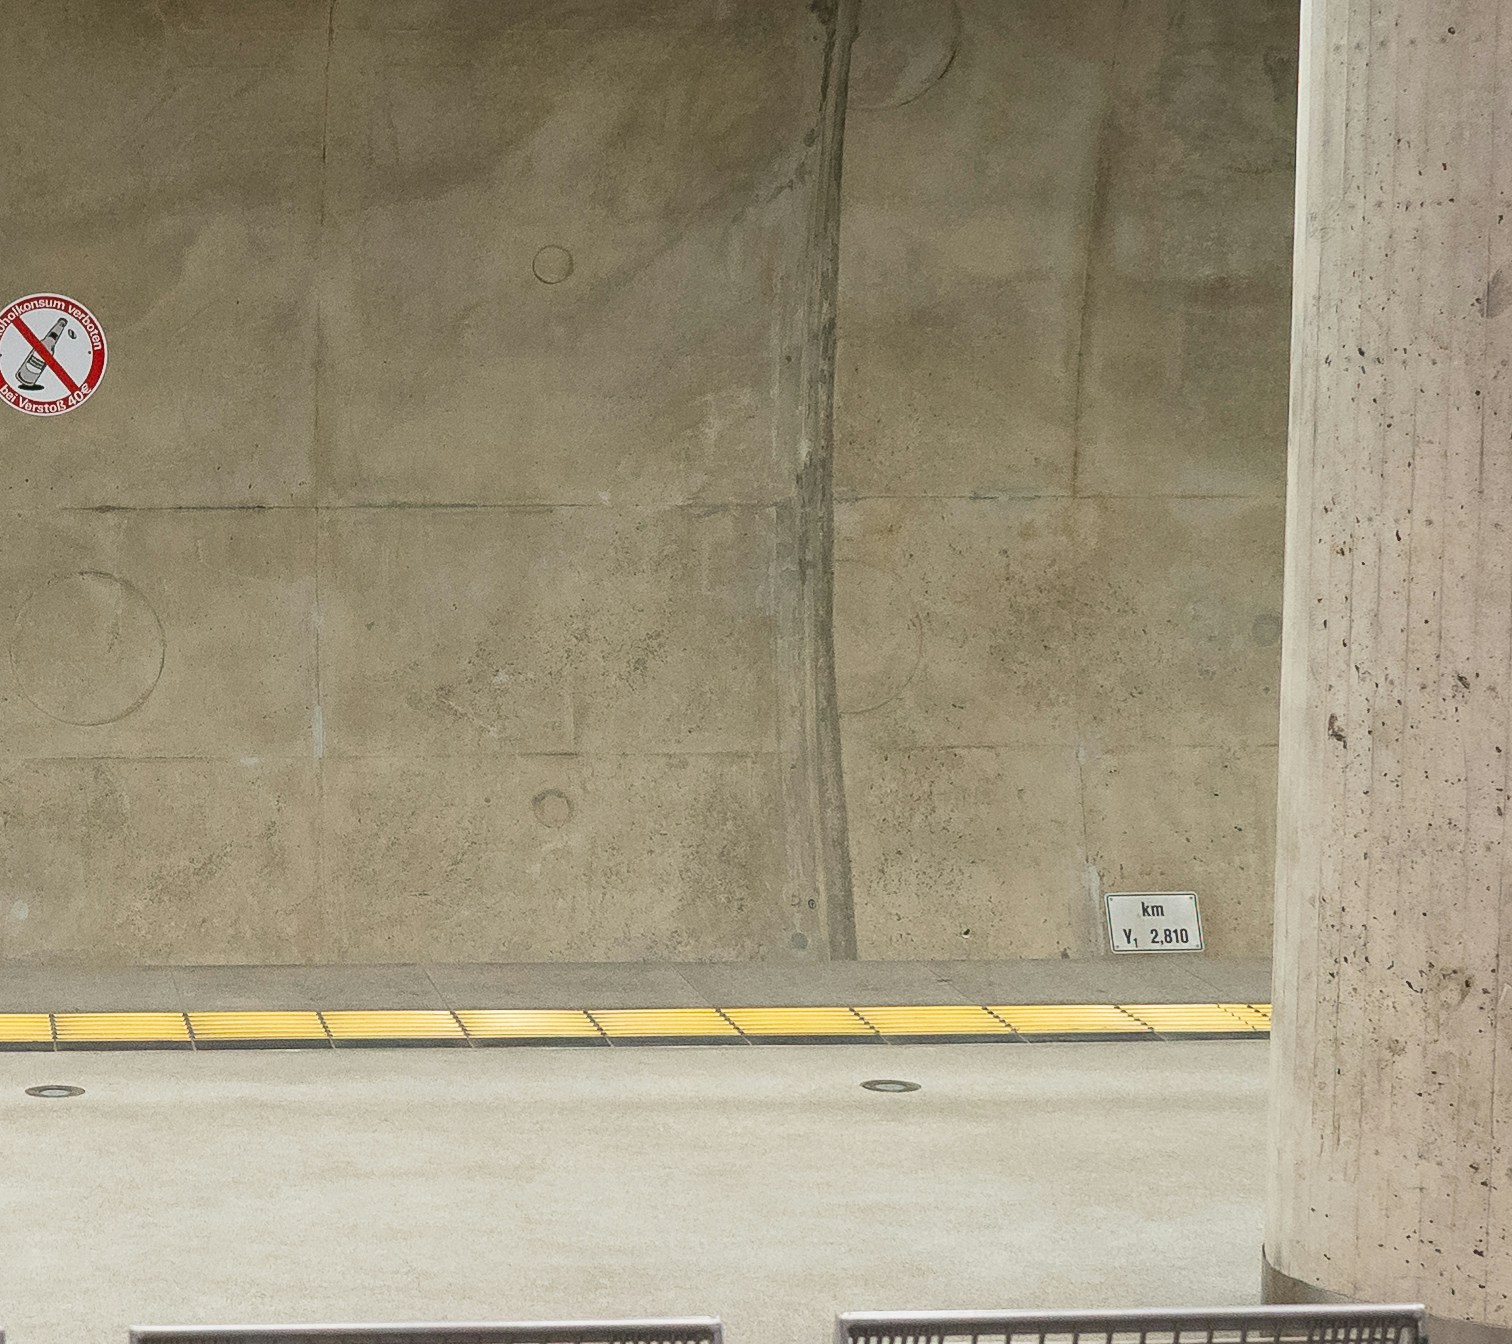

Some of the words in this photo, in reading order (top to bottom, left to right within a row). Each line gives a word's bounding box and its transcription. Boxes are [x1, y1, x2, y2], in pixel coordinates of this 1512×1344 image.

[67, 304, 103, 351] verboten
[0, 384, 17, 402] bei
[19, 399, 67, 414] Verstoß
[1141, 901, 1165, 917] km
[1150, 928, 1189, 945] 2,810
